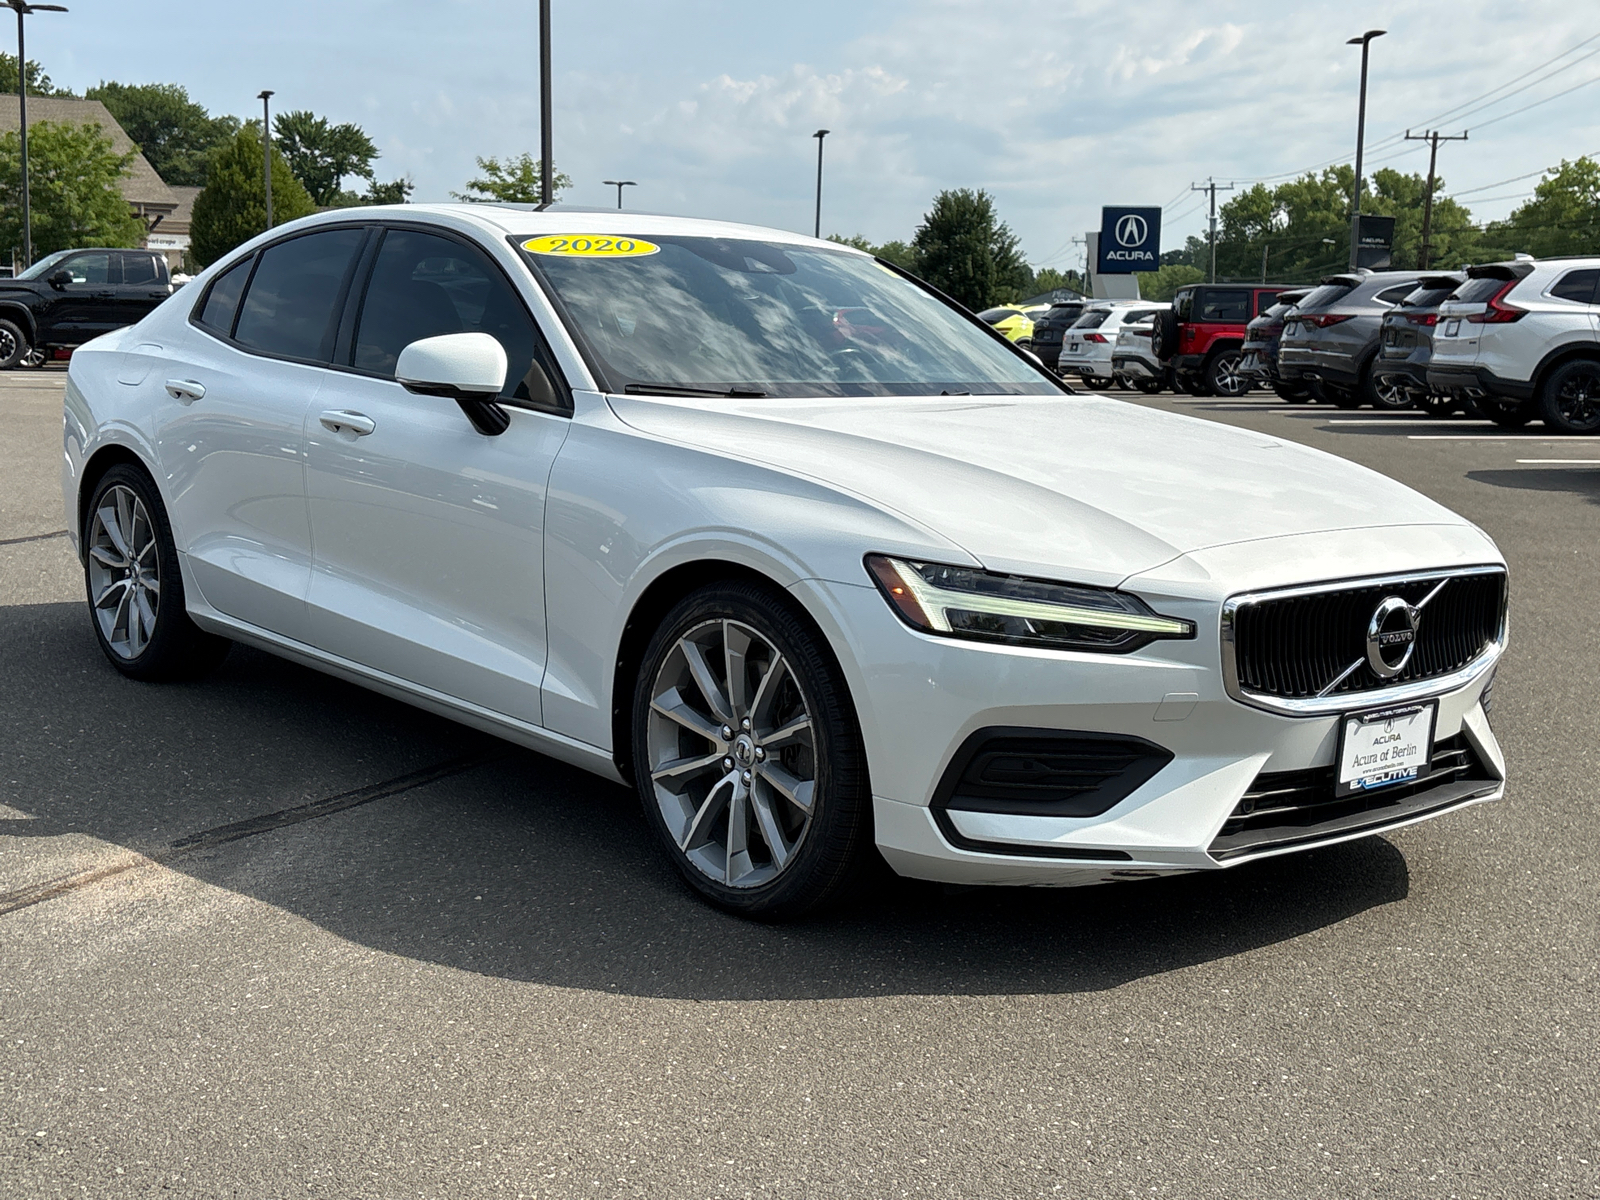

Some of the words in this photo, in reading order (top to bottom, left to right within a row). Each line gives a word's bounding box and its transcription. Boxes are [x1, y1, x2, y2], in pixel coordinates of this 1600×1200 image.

[549, 239, 636, 252] 2020
[1106, 250, 1154, 260] ACURA
[1381, 632, 1413, 644] VOLVO
[1372, 733, 1402, 746] ACURA
[1352, 753, 1378, 768] Acura
[1379, 748, 1390, 762] of
[1391, 743, 1417, 760] Berlin
[1349, 766, 1418, 790] EXECUTIVE
